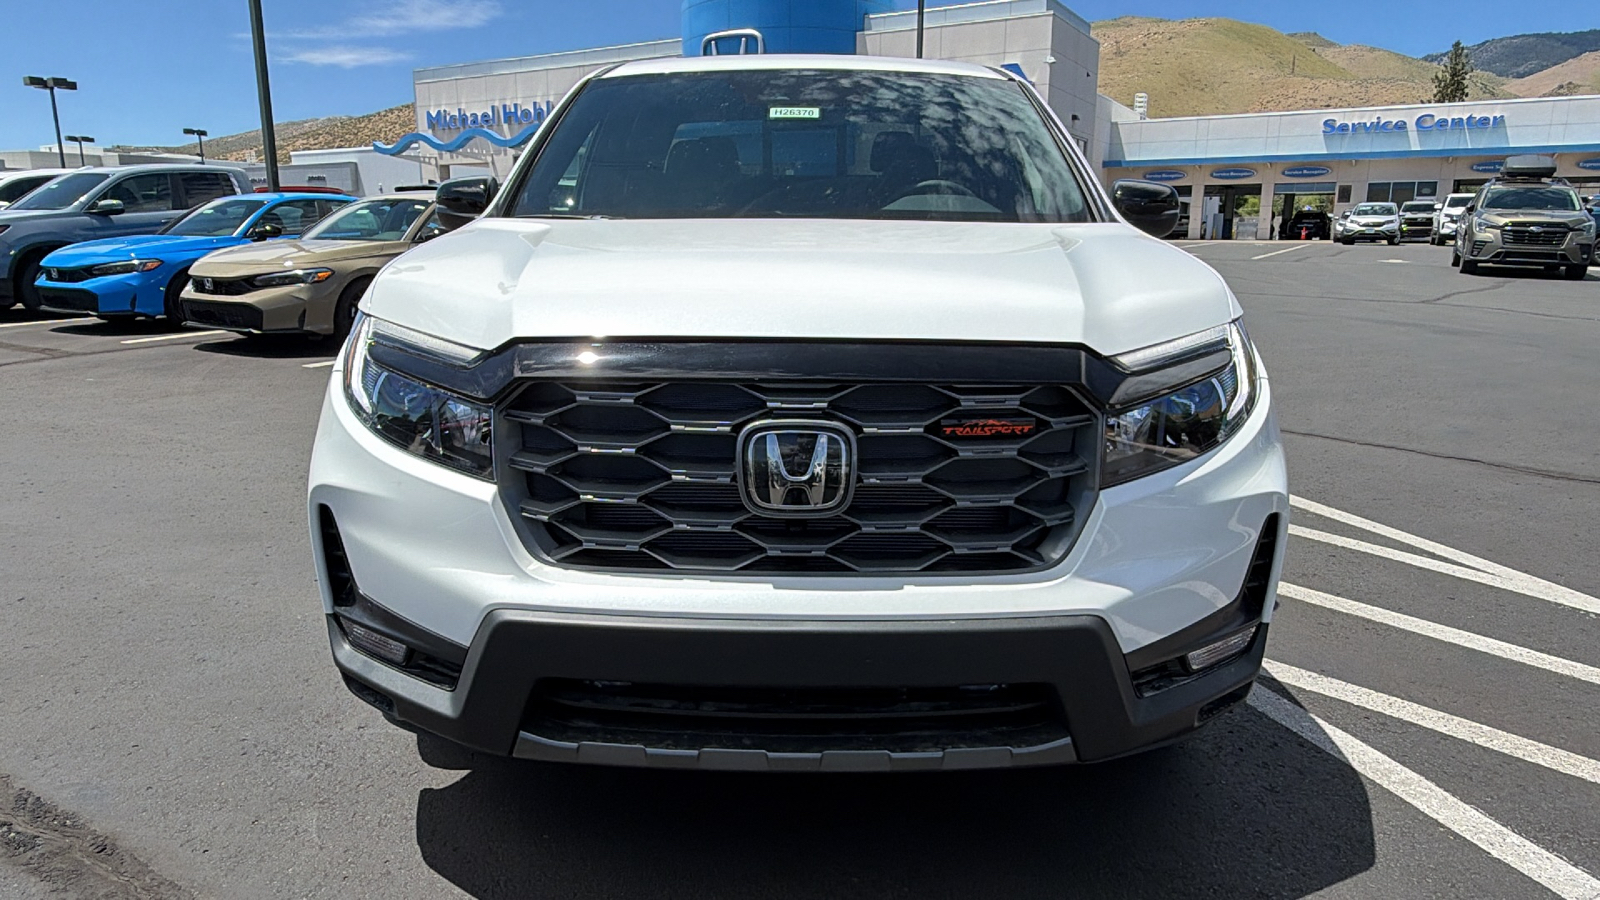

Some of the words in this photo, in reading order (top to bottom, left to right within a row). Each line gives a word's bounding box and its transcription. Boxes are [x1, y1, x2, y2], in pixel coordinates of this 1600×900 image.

[426, 105, 496, 130] Michael
[774, 108, 814, 116] H26370
[1322, 116, 1407, 134] Service
[1415, 113, 1505, 131] Center
[942, 425, 1034, 436] TRAILSPORT
